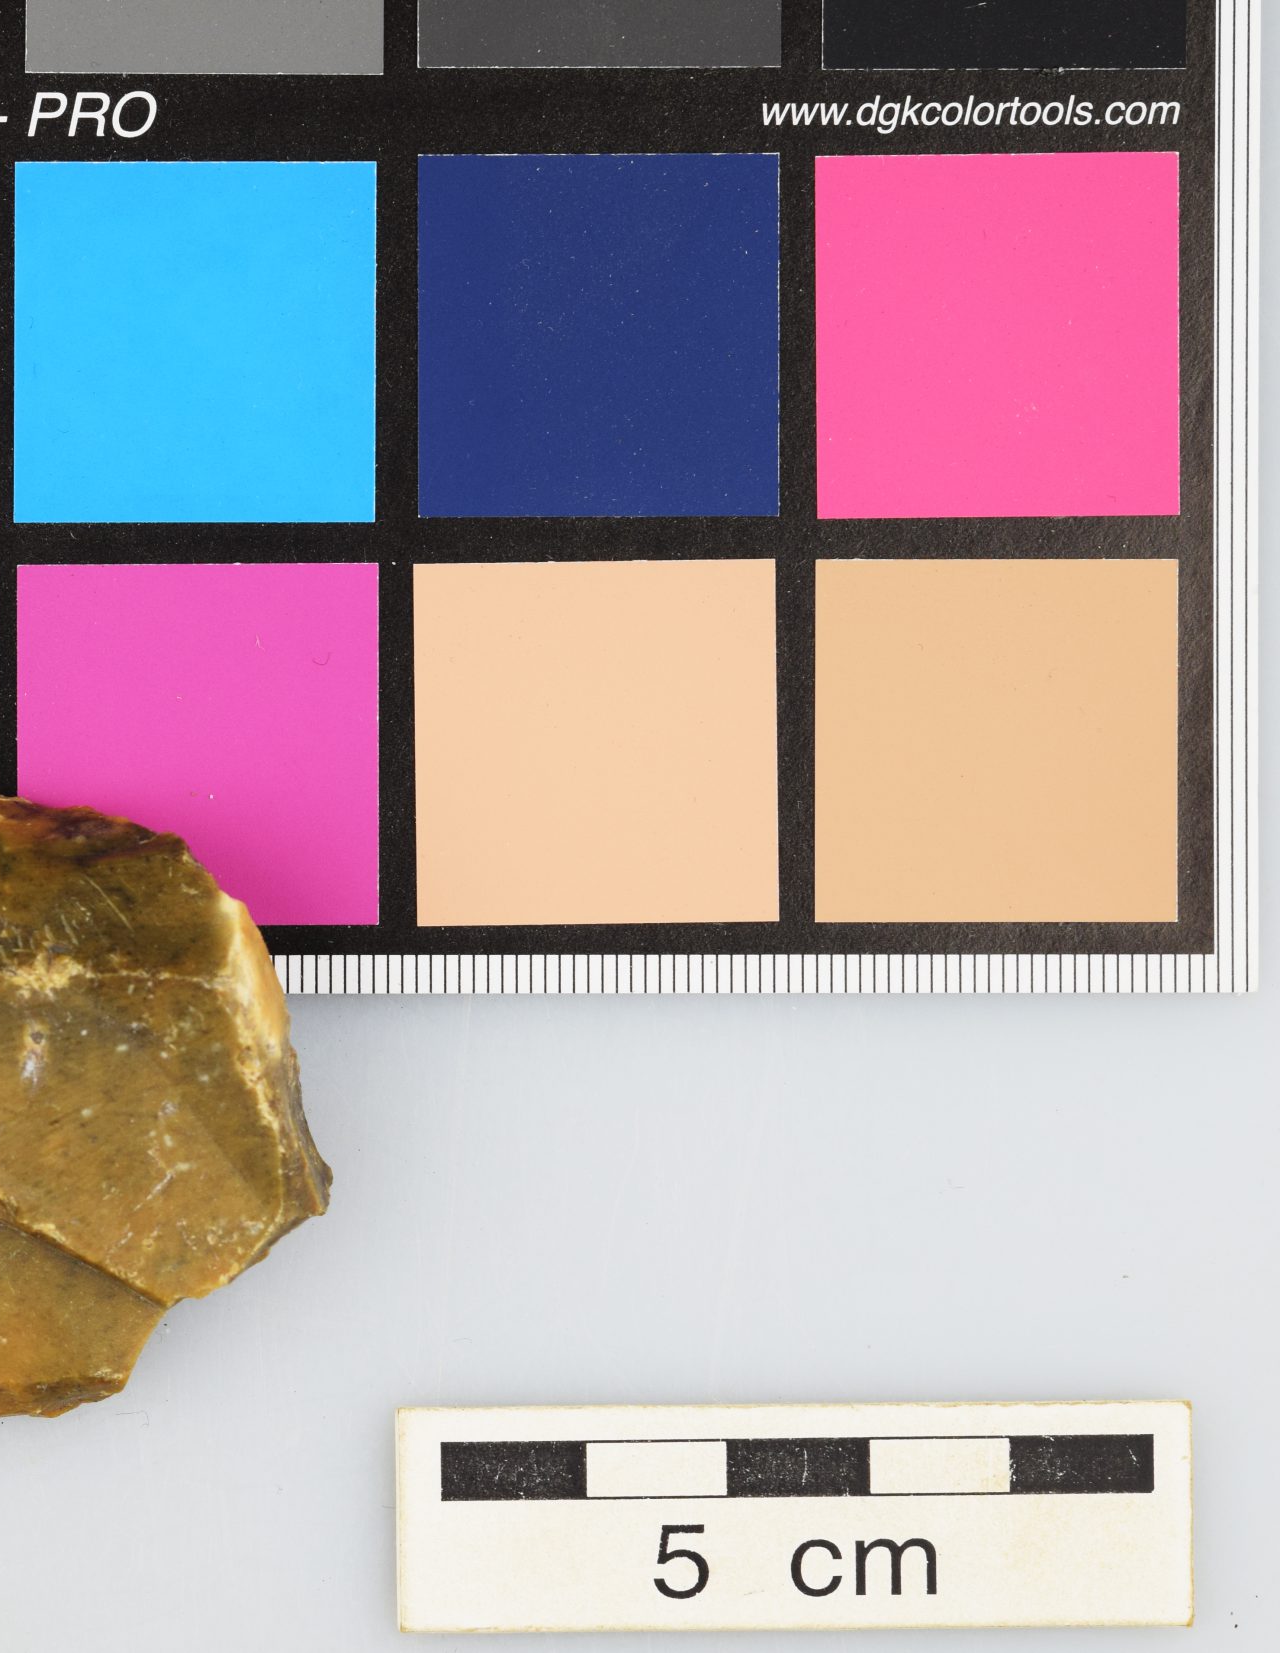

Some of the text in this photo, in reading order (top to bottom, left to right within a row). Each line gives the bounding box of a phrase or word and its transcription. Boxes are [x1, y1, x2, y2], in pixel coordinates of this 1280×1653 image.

[27, 90, 158, 139] PRO
[762, 94, 1181, 135] www.dgkcolortools.com
[653, 1524, 938, 1600] 5 cm
